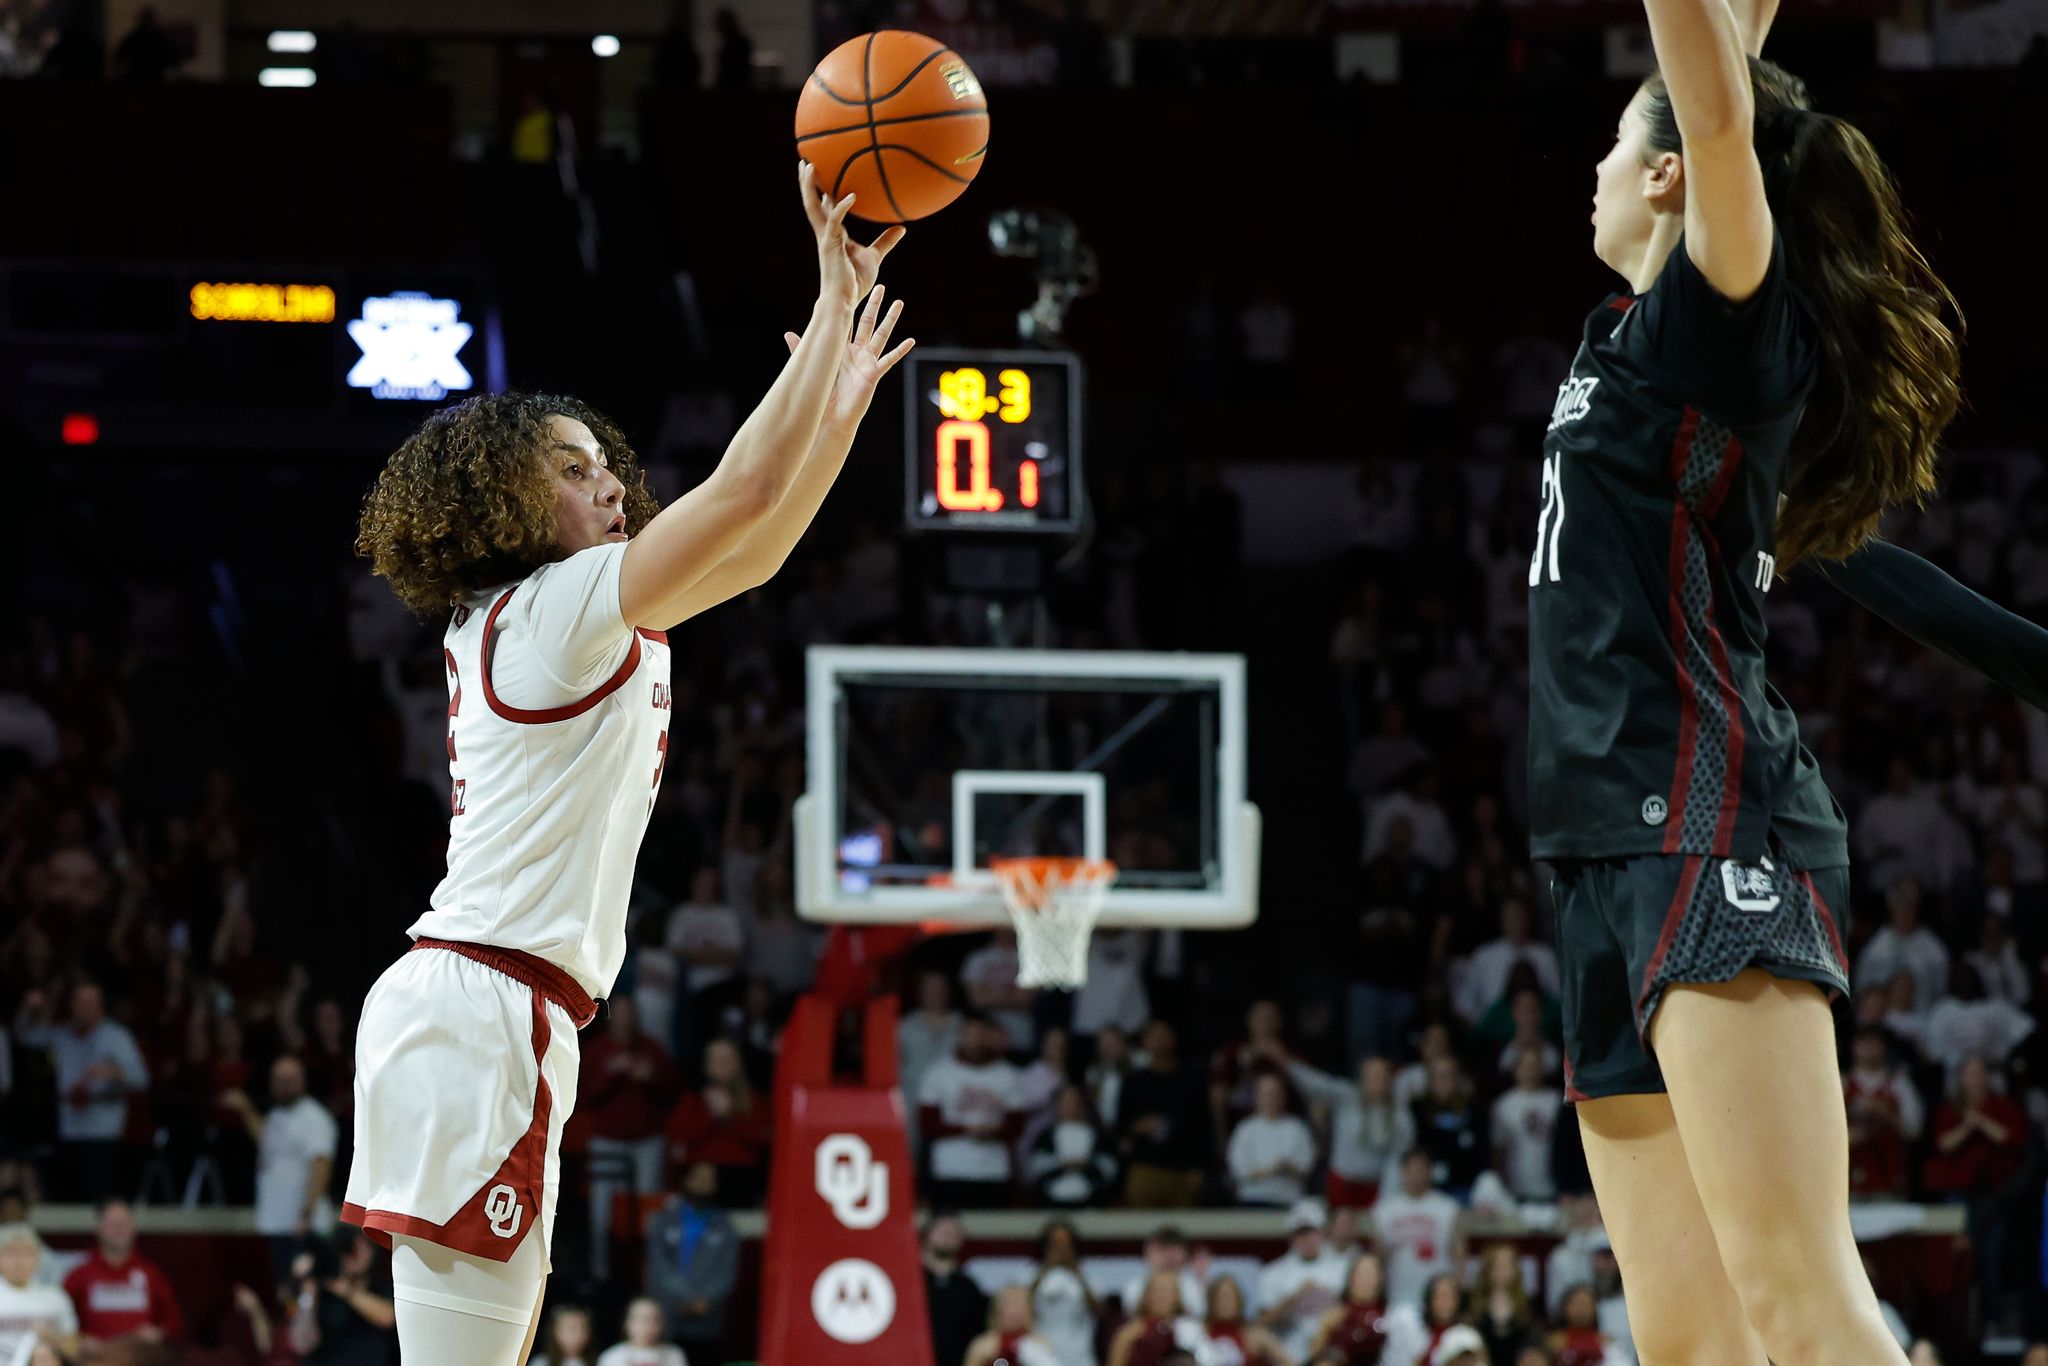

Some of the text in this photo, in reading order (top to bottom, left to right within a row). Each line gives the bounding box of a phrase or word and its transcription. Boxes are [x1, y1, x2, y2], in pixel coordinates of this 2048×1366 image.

[936, 419, 1039, 512] 0.1
[484, 1183, 523, 1239] OU
[815, 1133, 890, 1230] OU
